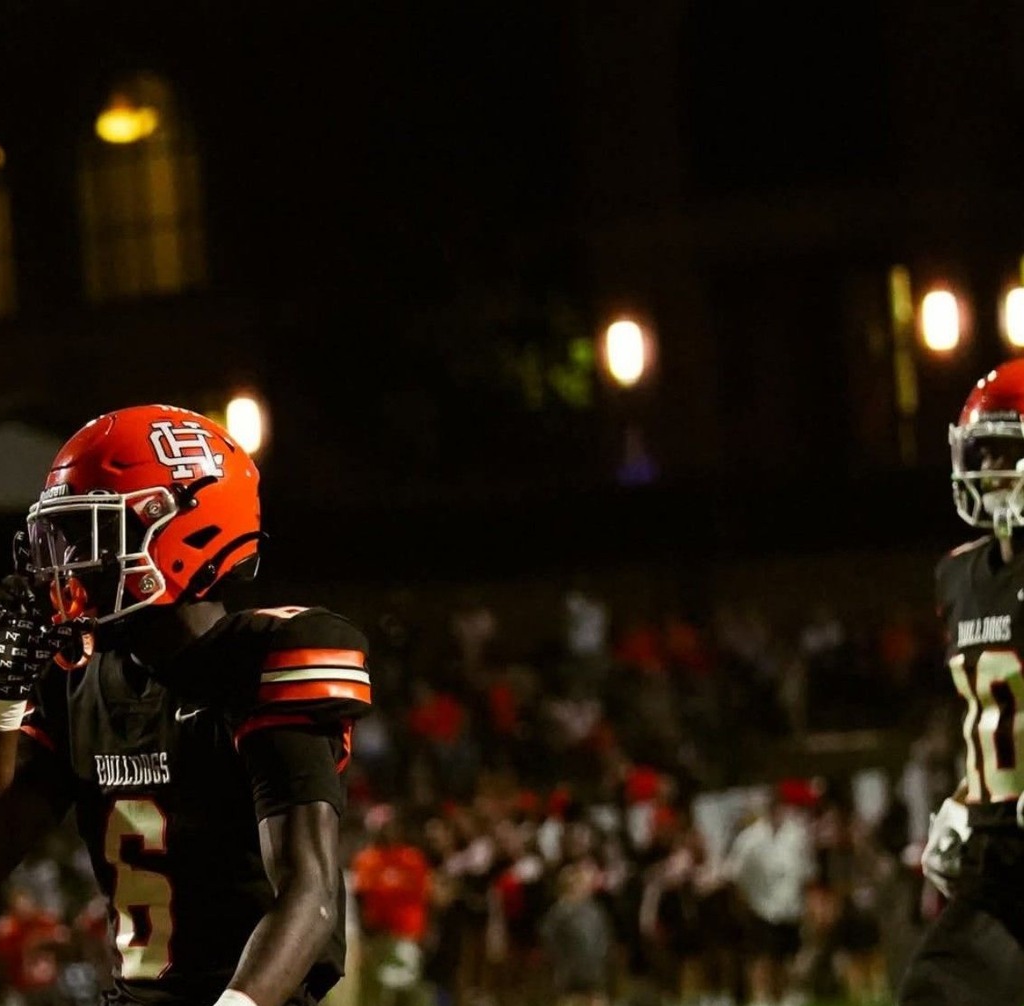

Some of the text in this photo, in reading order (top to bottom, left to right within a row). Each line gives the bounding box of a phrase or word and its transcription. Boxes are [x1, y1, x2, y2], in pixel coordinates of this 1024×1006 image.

[957, 614, 1012, 647] BULLDOGS
[94, 751, 171, 786] BULLDOGS
[949, 651, 1024, 804] 10
[102, 795, 175, 982] 6
